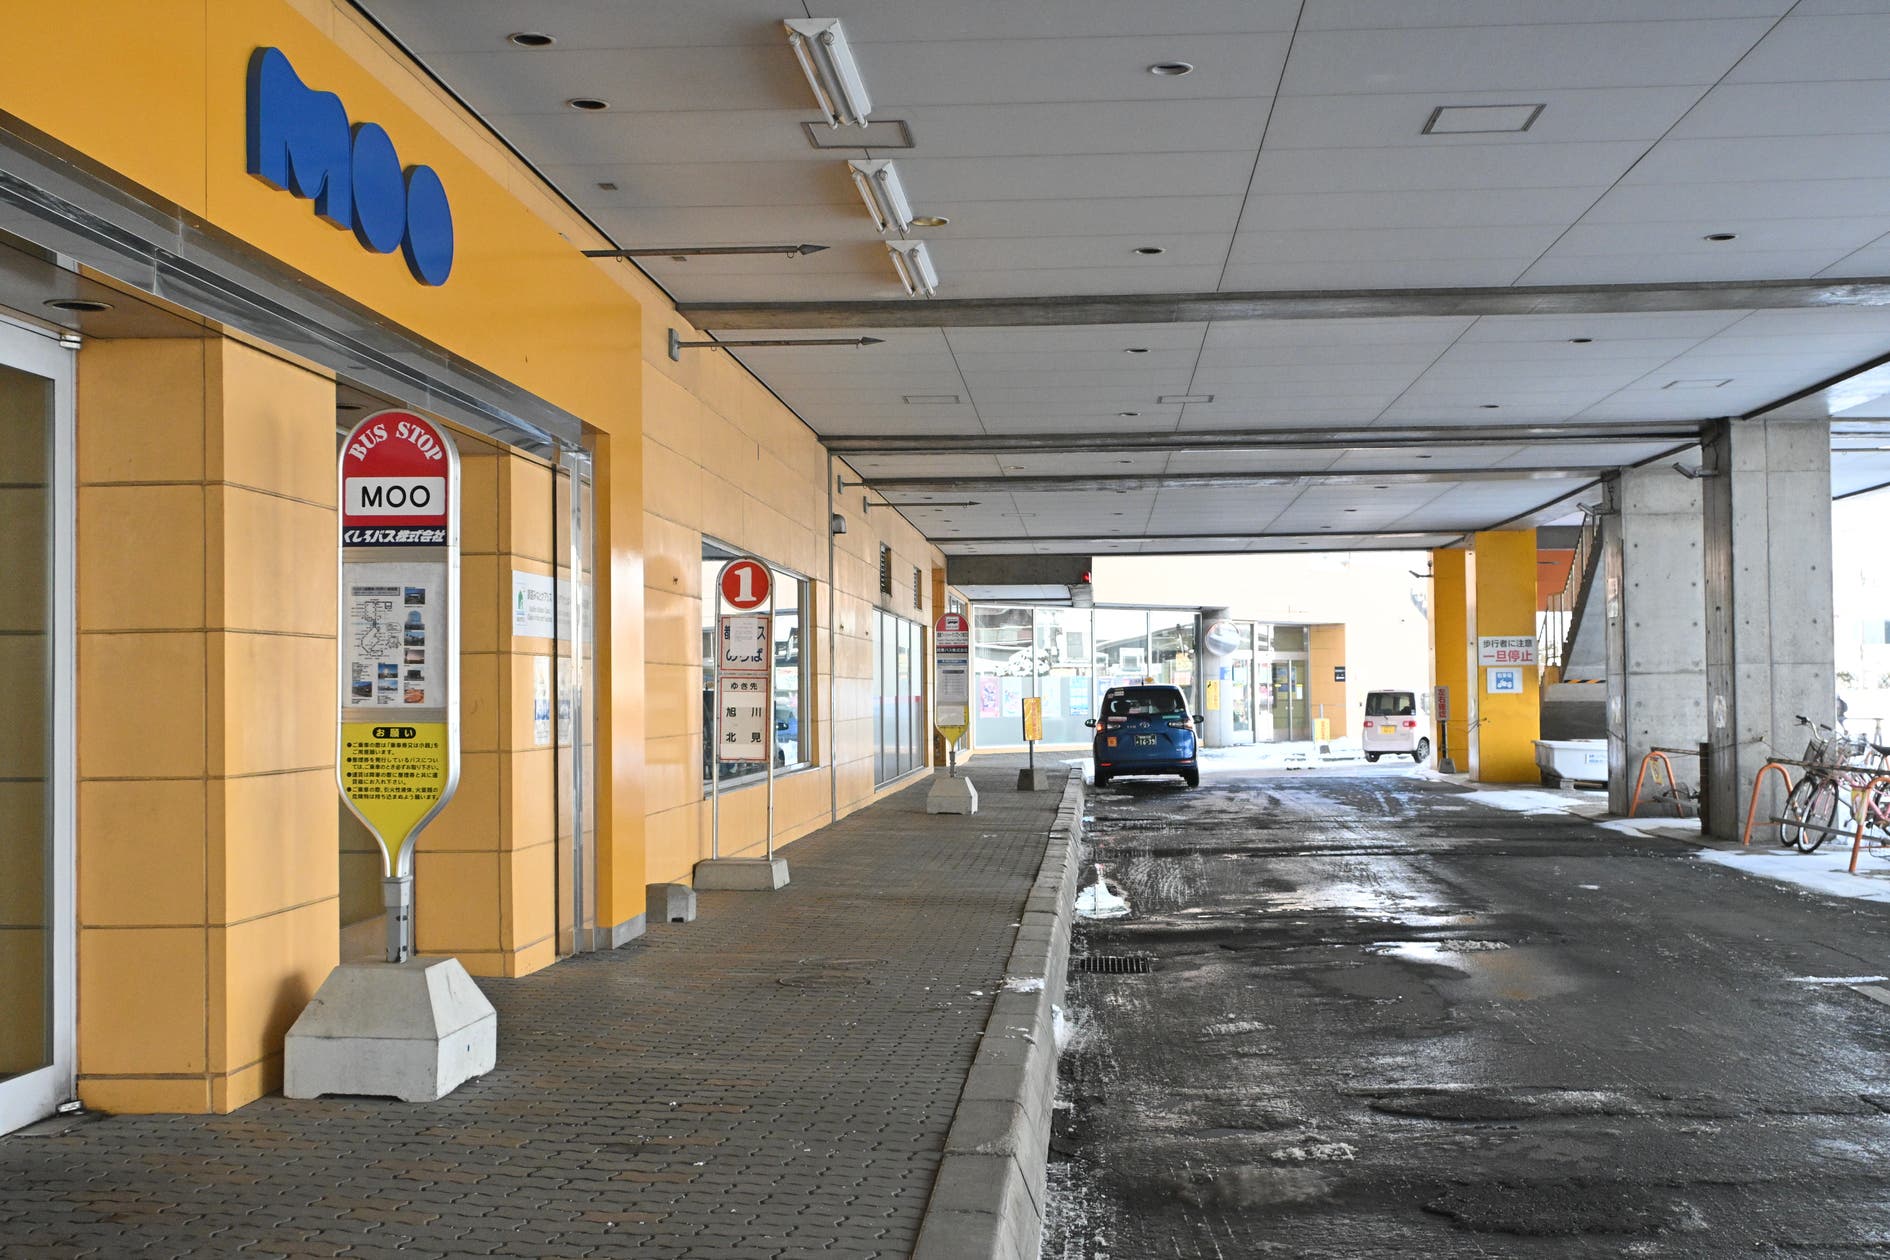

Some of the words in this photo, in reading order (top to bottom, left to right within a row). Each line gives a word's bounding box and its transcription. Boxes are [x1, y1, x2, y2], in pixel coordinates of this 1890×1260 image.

[246, 47, 454, 286] MOO
[349, 424, 388, 461] BUS
[396, 421, 443, 460] STOP
[361, 485, 430, 507] MOO
[344, 530, 446, 542] くしろバス株式会社
[734, 567, 757, 602] 1
[1483, 639, 1533, 648] 歩行者に注意
[1483, 650, 1533, 662] 一旦停止
[730, 682, 758, 690] ゆき先
[726, 707, 762, 717] 旭川
[375, 728, 413, 737] お願い
[726, 732, 762, 743] 北見
